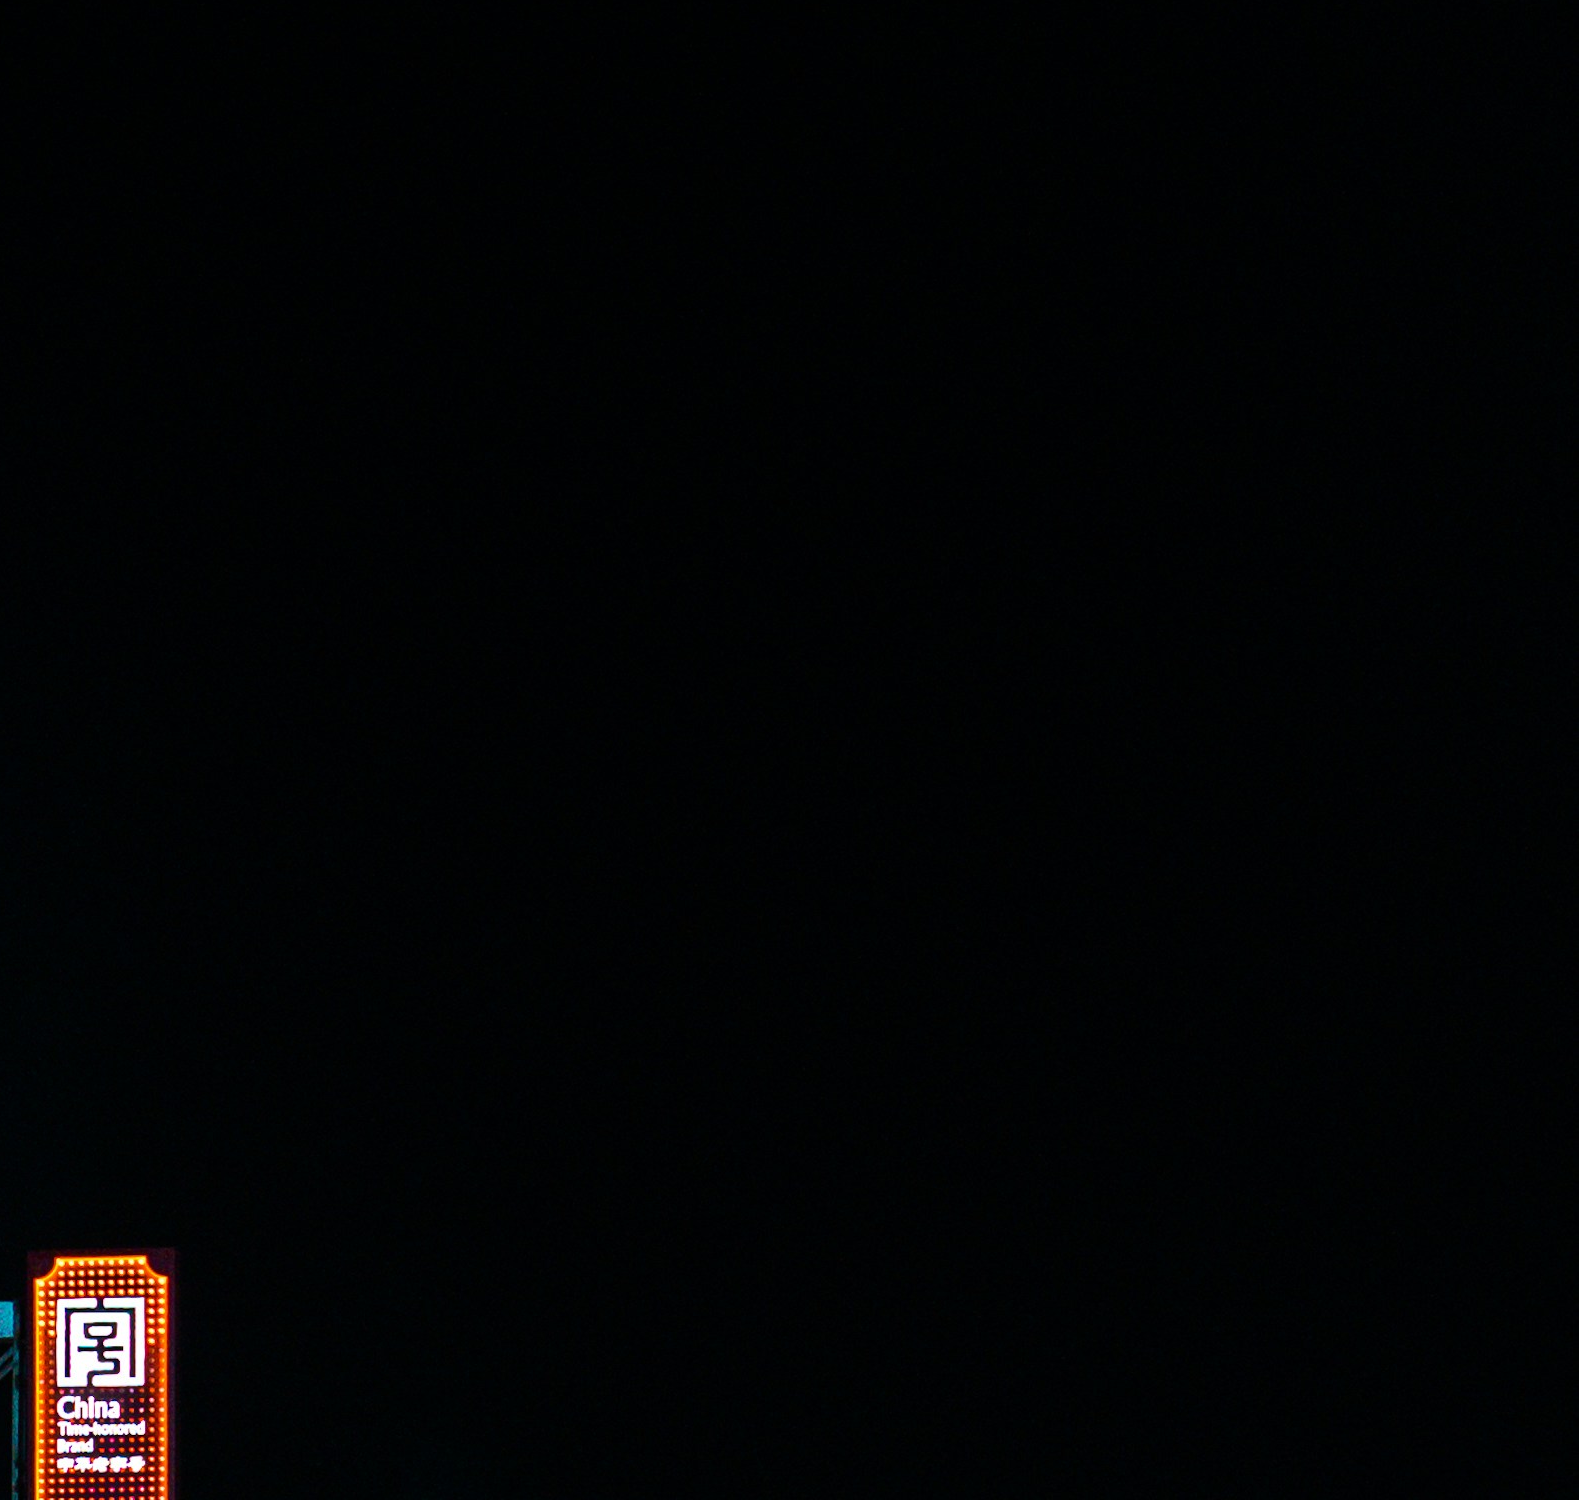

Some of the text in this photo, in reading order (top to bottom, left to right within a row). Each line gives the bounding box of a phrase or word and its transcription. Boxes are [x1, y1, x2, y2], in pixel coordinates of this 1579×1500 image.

[57, 1396, 121, 1420] China
[57, 1421, 145, 1436] Time-honored
[57, 1439, 94, 1454] Brand
